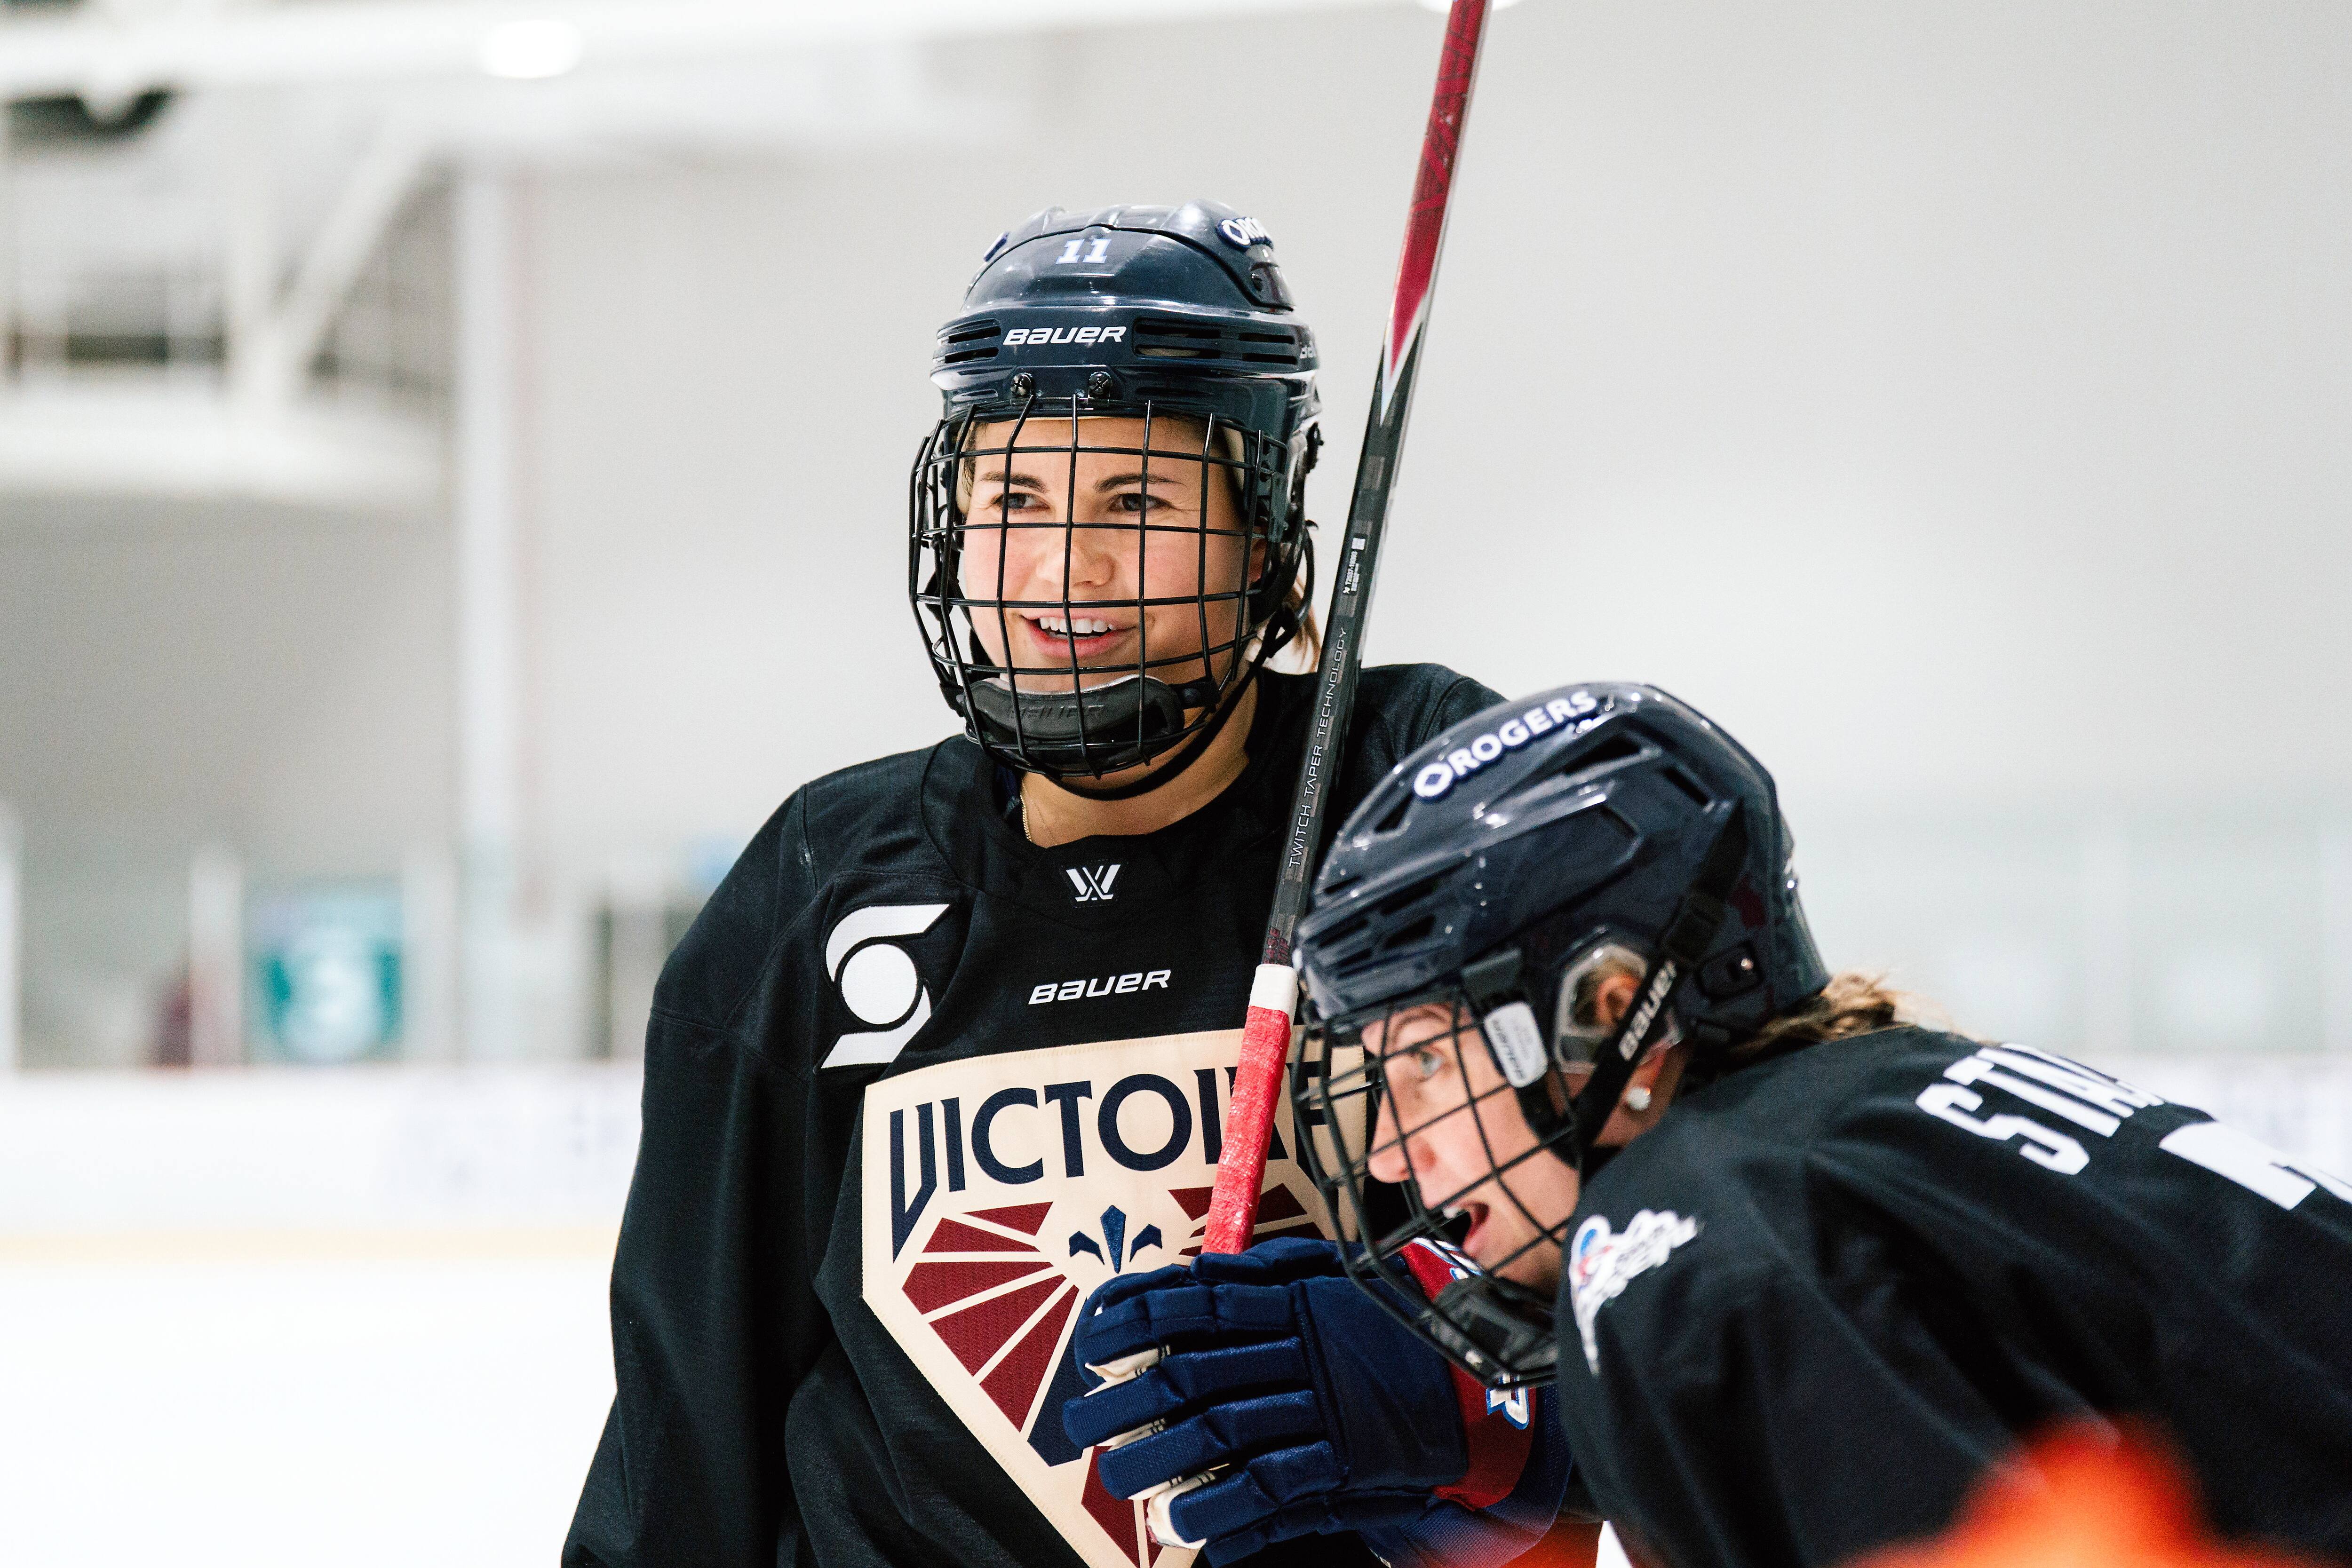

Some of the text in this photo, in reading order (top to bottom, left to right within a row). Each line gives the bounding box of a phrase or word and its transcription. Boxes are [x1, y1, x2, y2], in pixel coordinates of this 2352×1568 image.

[1056, 239, 1112, 264] 11
[1002, 326, 1127, 346] BAUER
[1289, 627, 1347, 868] TWITCH TAPER TECHNOLOGY
[1028, 969, 1172, 1005] BAUER
[890, 1060, 1339, 1264] VICTOIE
